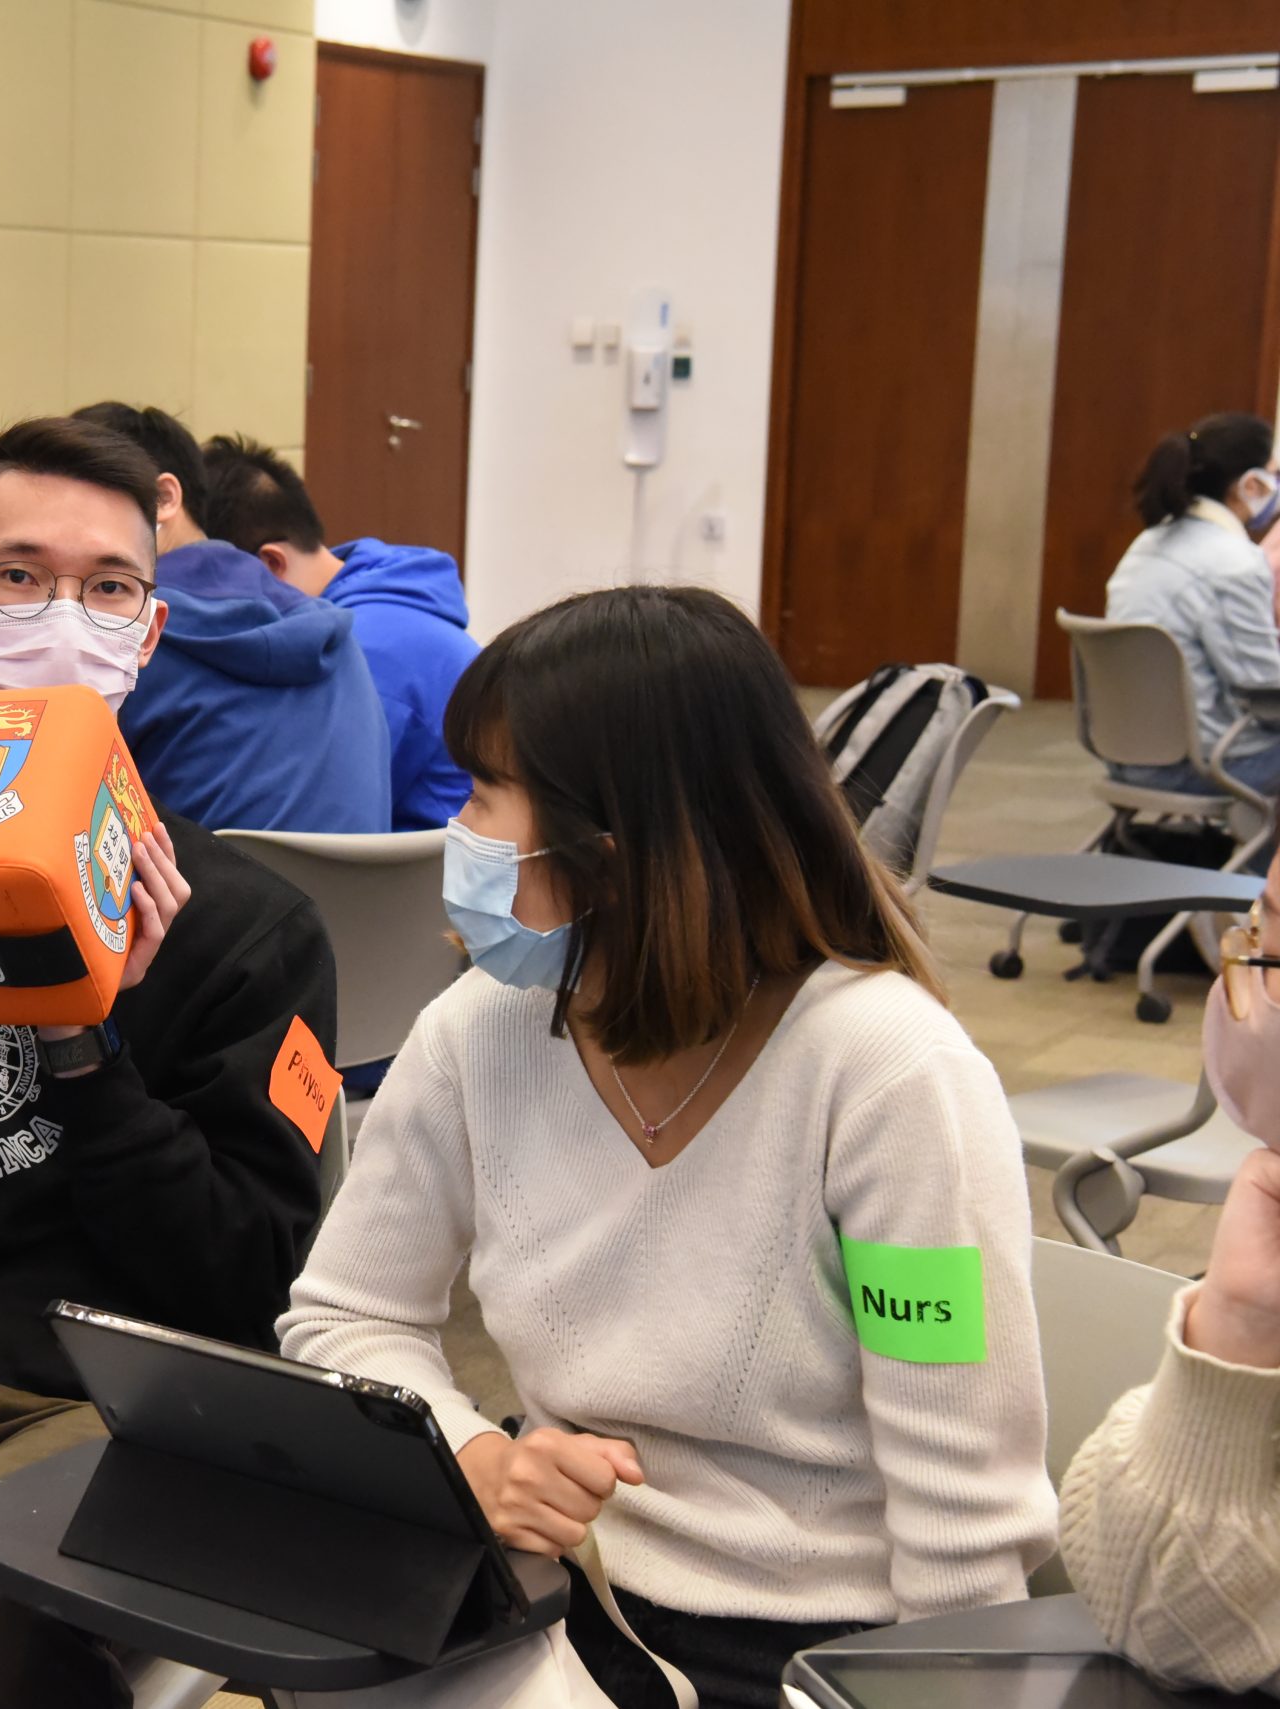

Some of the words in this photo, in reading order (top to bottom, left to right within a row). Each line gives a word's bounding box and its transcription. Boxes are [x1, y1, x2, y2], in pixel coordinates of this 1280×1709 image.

[75, 841, 95, 915] SAPIENTIA
[94, 915, 104, 934] ET
[861, 1284, 953, 1323] Nurs
